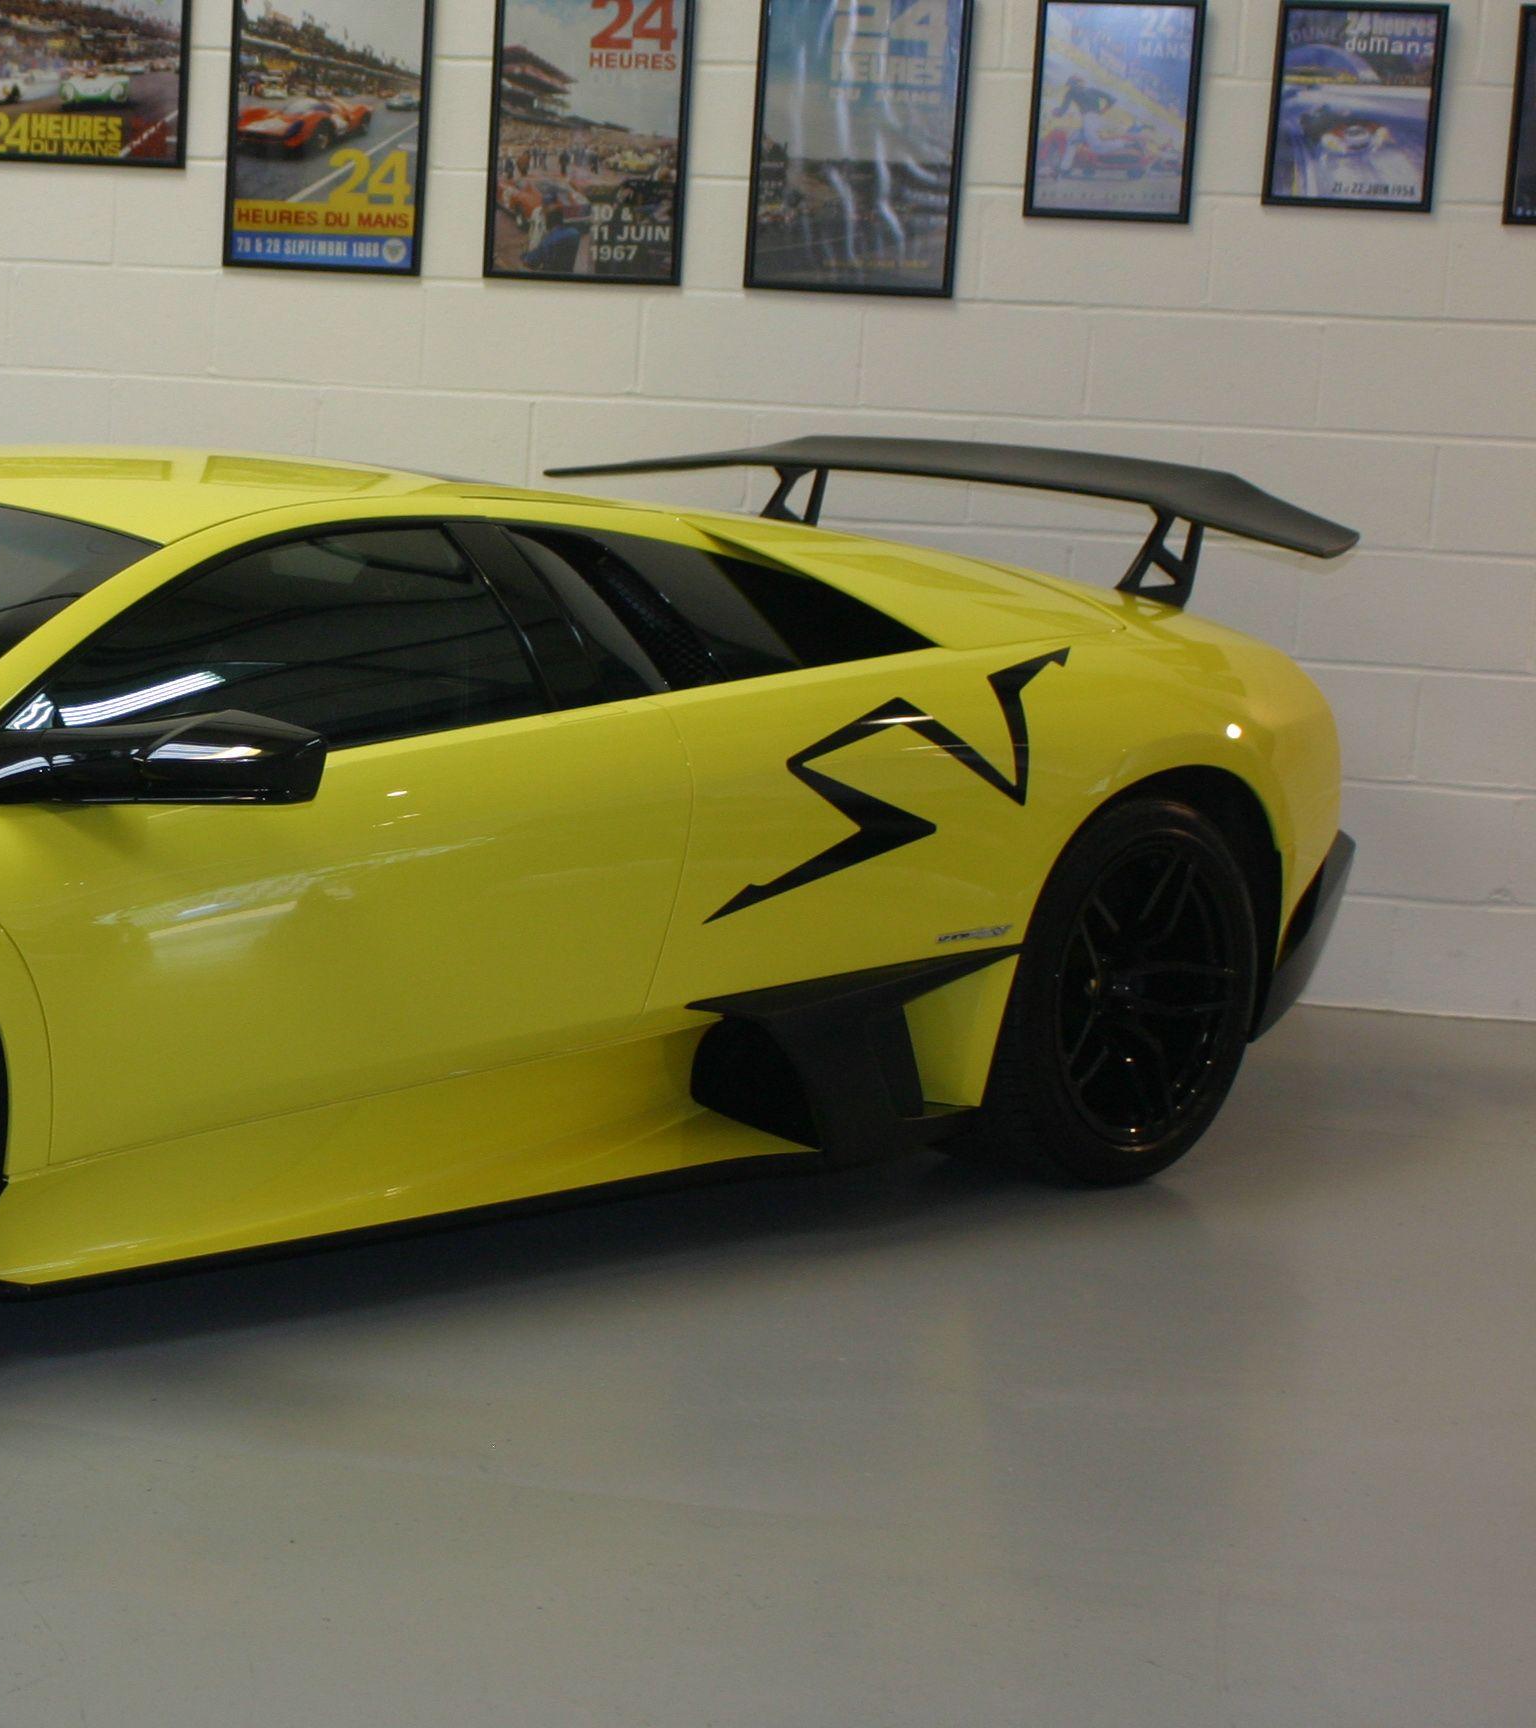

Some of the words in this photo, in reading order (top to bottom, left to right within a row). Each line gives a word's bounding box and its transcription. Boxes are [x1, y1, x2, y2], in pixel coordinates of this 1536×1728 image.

[590, 0, 677, 50] 24
[589, 52, 677, 71] HEURES
[30, 112, 123, 140] HEURES
[31, 139, 58, 155] DU
[64, 141, 121, 157] MANS
[329, 149, 411, 206] 24
[237, 208, 318, 226] HEURES
[324, 211, 350, 228] DU
[358, 211, 410, 229] MANS
[592, 204, 613, 221] 10
[621, 206, 633, 221] &
[592, 225, 609, 241] 11
[617, 225, 671, 242] JUIN
[590, 245, 638, 261] 1967
